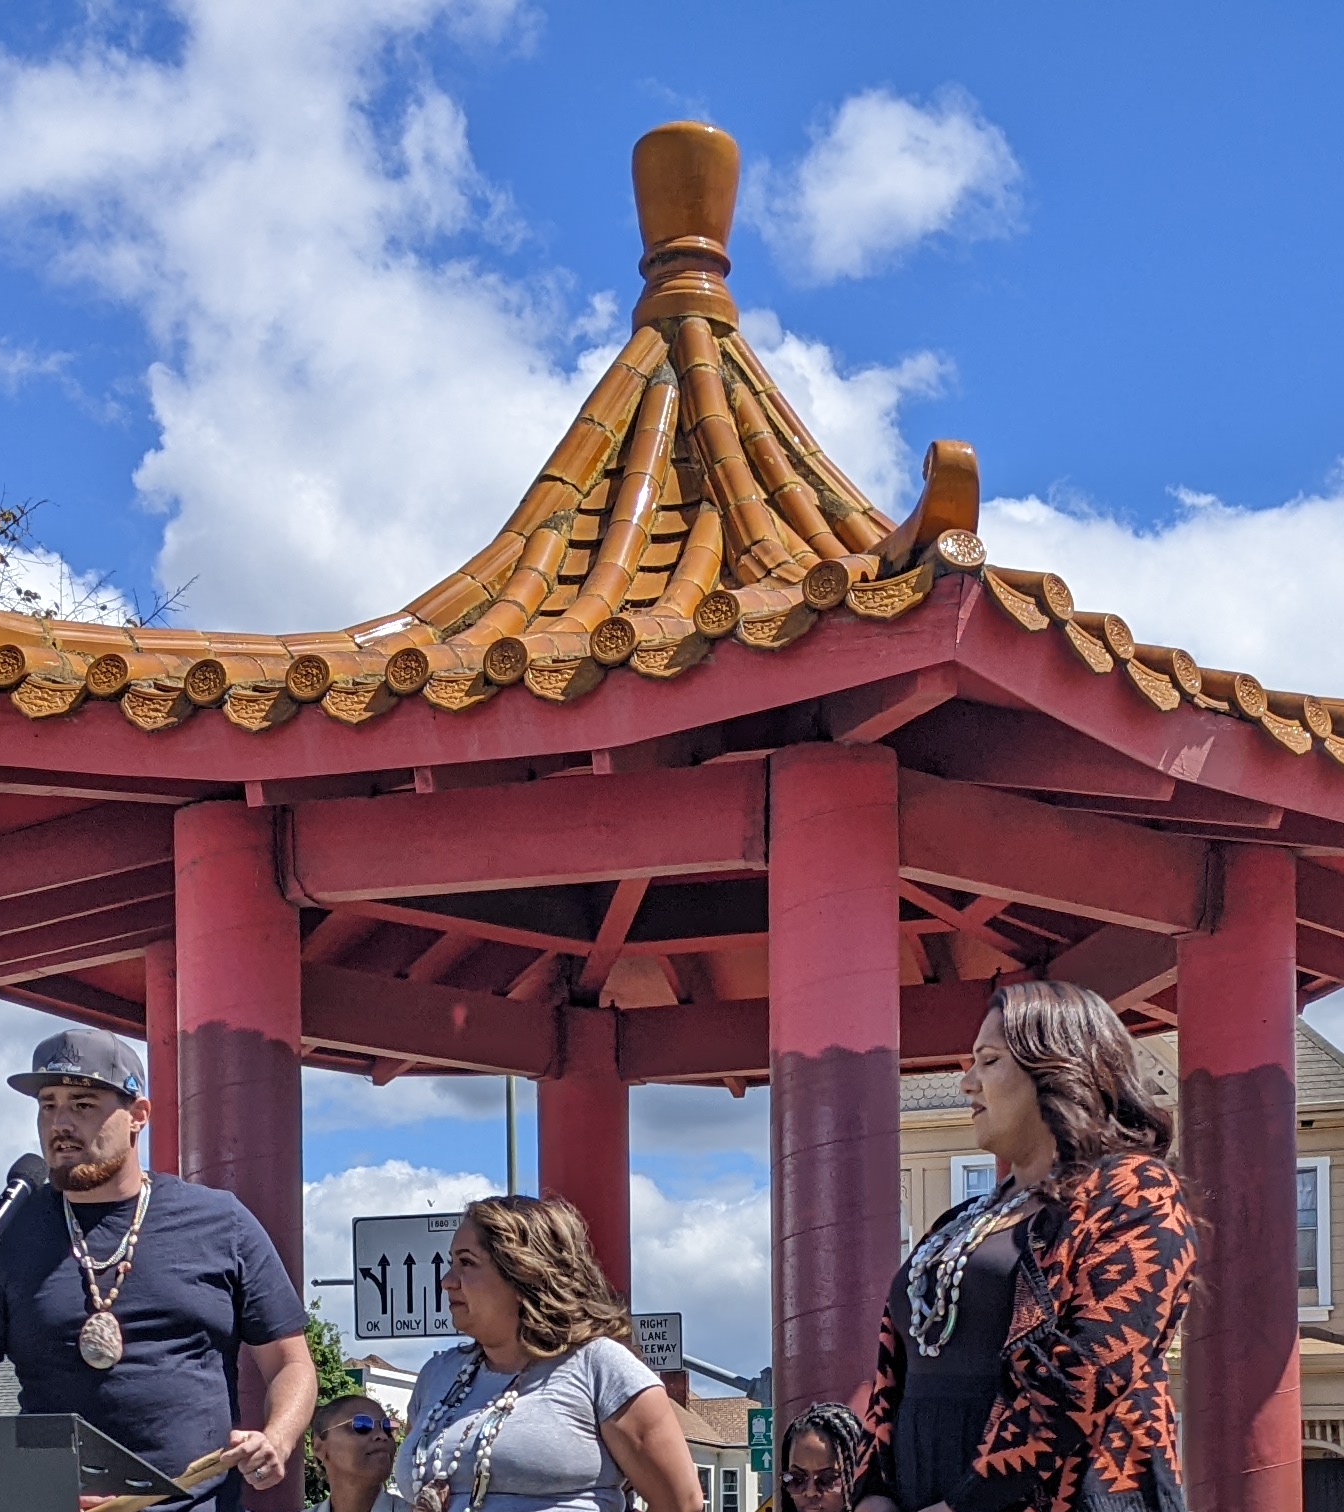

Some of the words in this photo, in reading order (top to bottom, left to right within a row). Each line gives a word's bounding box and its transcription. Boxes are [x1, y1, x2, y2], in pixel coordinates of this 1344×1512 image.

[366, 1320, 381, 1332] OK
[395, 1319, 423, 1331] ONLY
[433, 1318, 449, 1330] OK
[639, 1318, 668, 1329] RIGHT
[641, 1330, 668, 1342] LANE
[636, 1342, 678, 1354] REEWAY
[643, 1356, 668, 1366] ONLY
